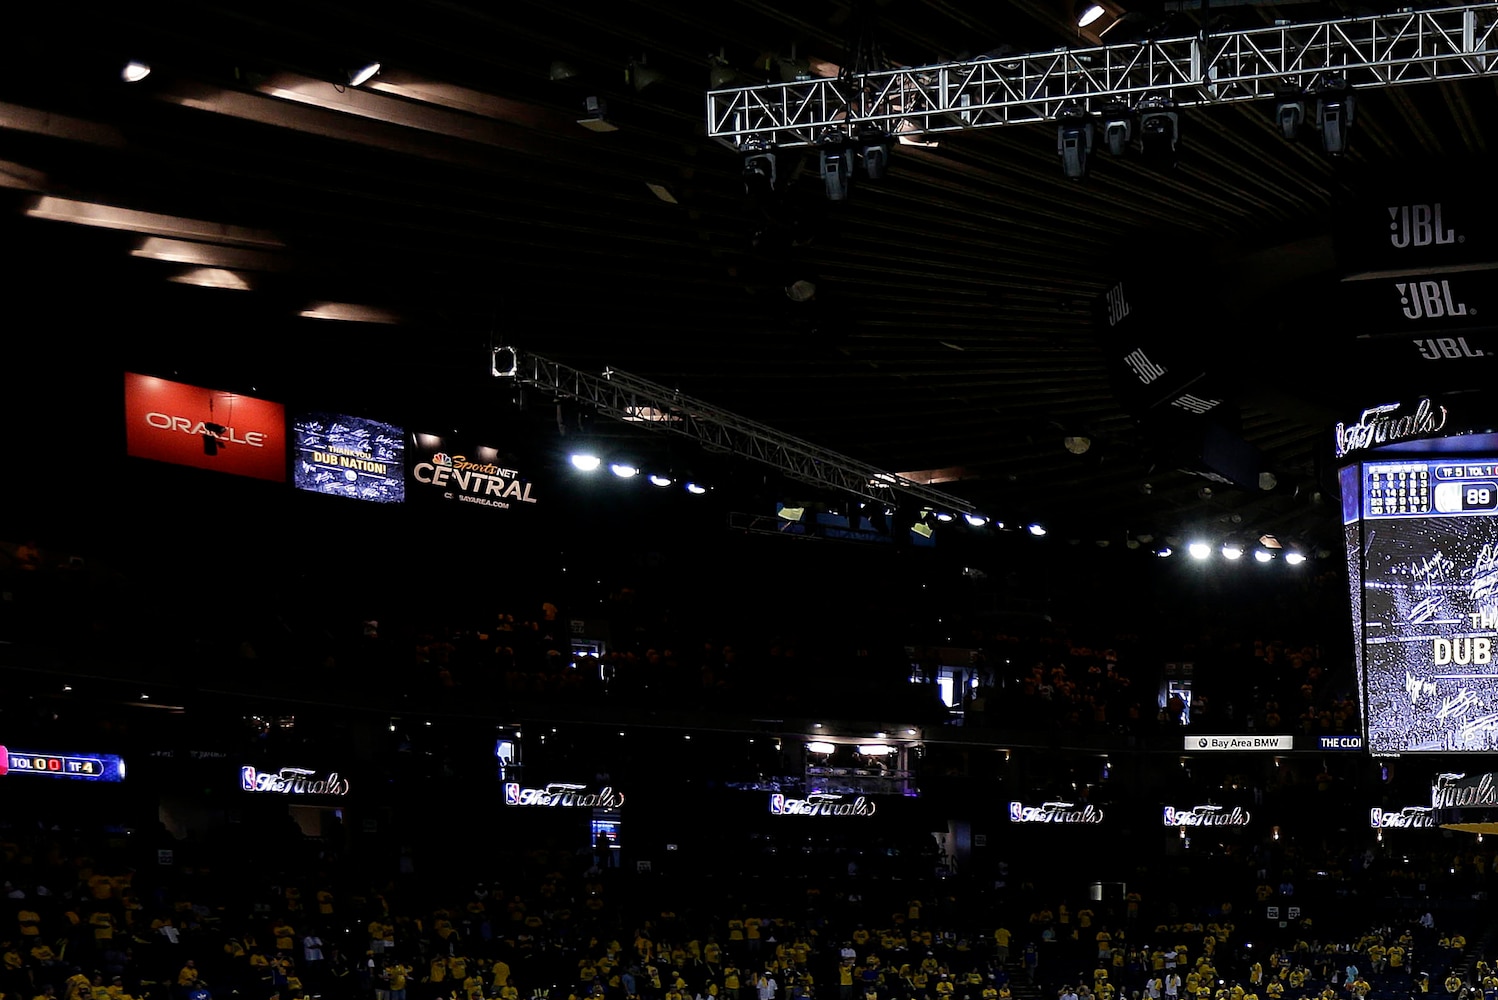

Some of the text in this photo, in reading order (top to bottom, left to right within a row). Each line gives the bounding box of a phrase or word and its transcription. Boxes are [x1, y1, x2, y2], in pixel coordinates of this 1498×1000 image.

[1389, 202, 1455, 248] JBL
[1106, 281, 1131, 326] JBL
[1396, 279, 1467, 319] JBL
[1413, 336, 1484, 359] JBL
[1124, 347, 1166, 385] JBL
[1344, 399, 1447, 454] The Finals
[328, 445, 353, 457] THANK
[313, 451, 387, 475] DUB NATION!
[1443, 467, 1463, 477] TF 5
[1468, 467, 1484, 476] TOL
[413, 461, 538, 504] CENTRAL
[444, 491, 510, 510] CSBAYAREA.COM
[1467, 489, 1490, 504] 89
[1434, 637, 1492, 666] DUB
[1212, 738, 1280, 748] Bay Area BMW
[1320, 738, 1361, 748] THE CLO
[11, 758, 60, 771] TOL 0 0
[69, 761, 93, 772] TF 4
[256, 768, 352, 796] The Finals
[519, 784, 625, 809] The Finals
[785, 794, 877, 817] The Finals
[1021, 801, 1104, 824] The Finals
[1175, 804, 1252, 828] The Finals
[1382, 811, 1406, 828] The
